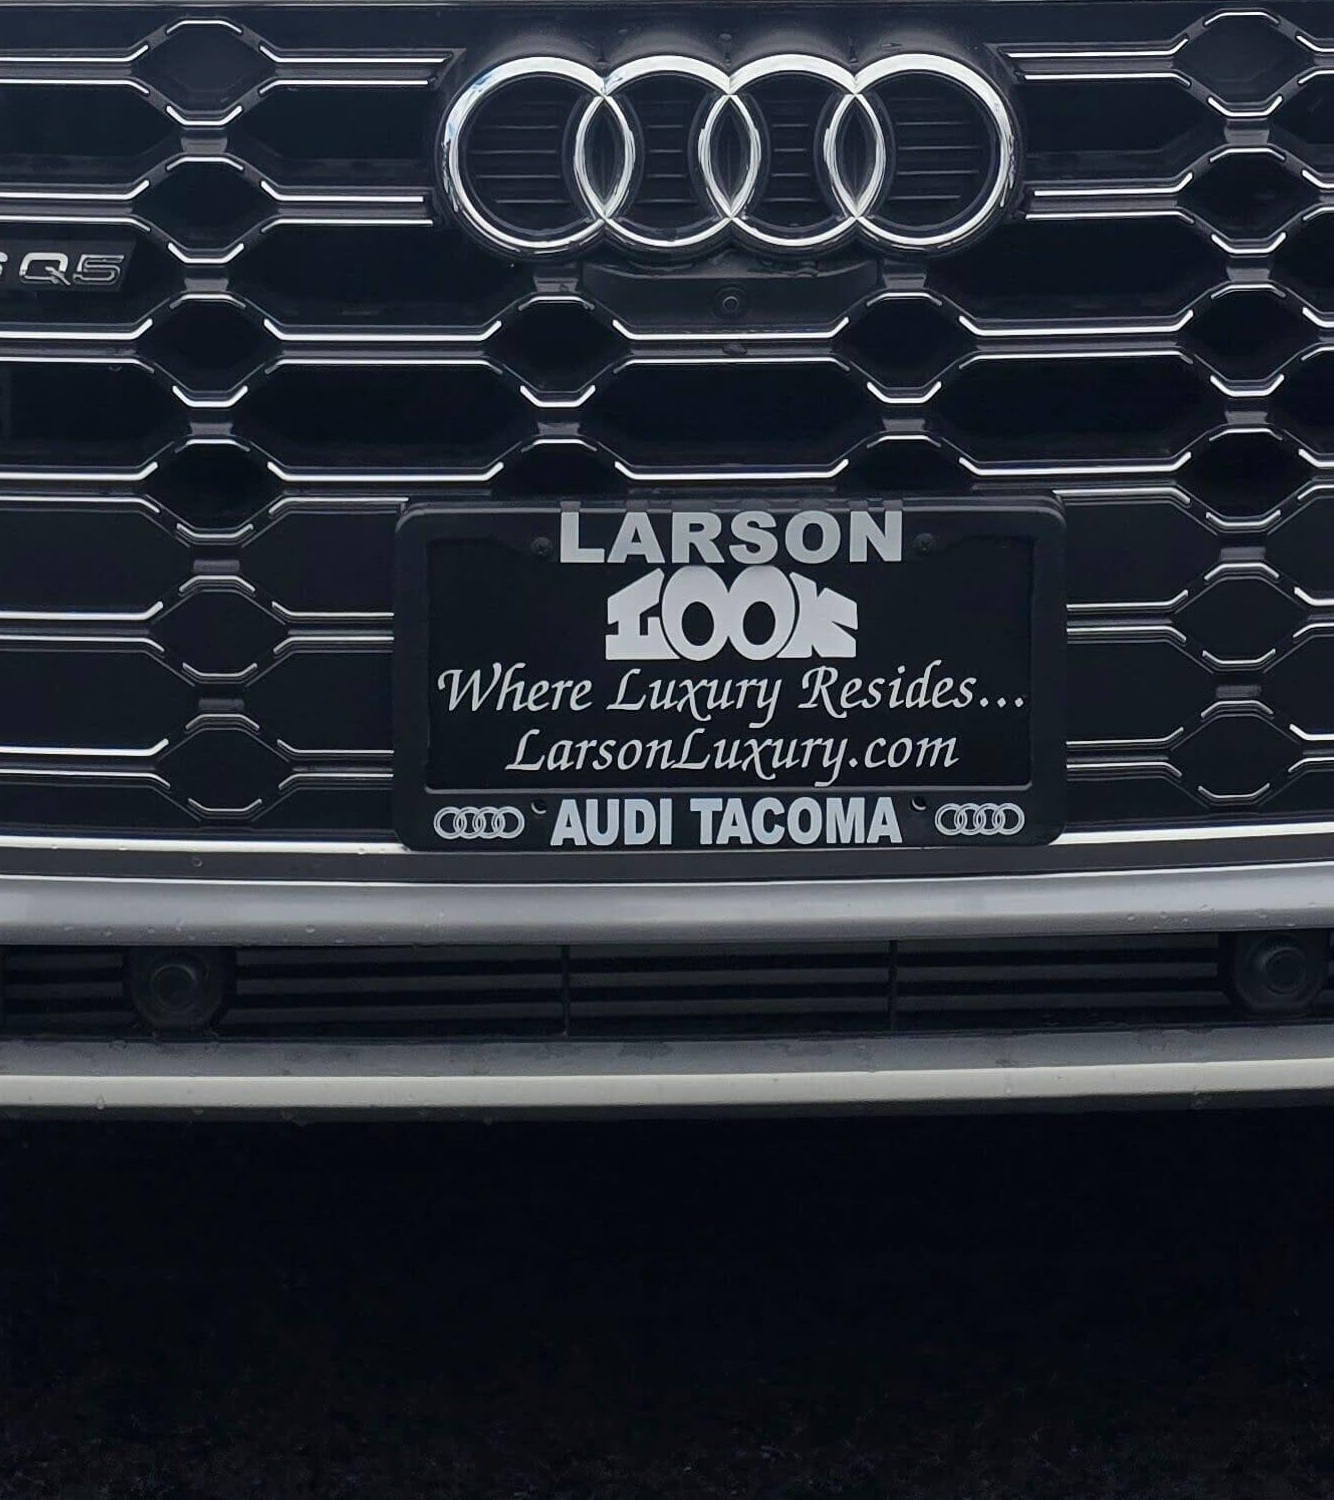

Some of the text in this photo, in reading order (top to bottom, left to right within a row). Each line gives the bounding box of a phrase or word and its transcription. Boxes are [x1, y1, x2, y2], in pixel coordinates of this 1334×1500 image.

[559, 510, 903, 563] LARSON
[436, 659, 1025, 729] Where Luxury Resides...
[504, 727, 960, 788] LarsonLuxury.com
[550, 797, 903, 846] AUDI TACOMA
